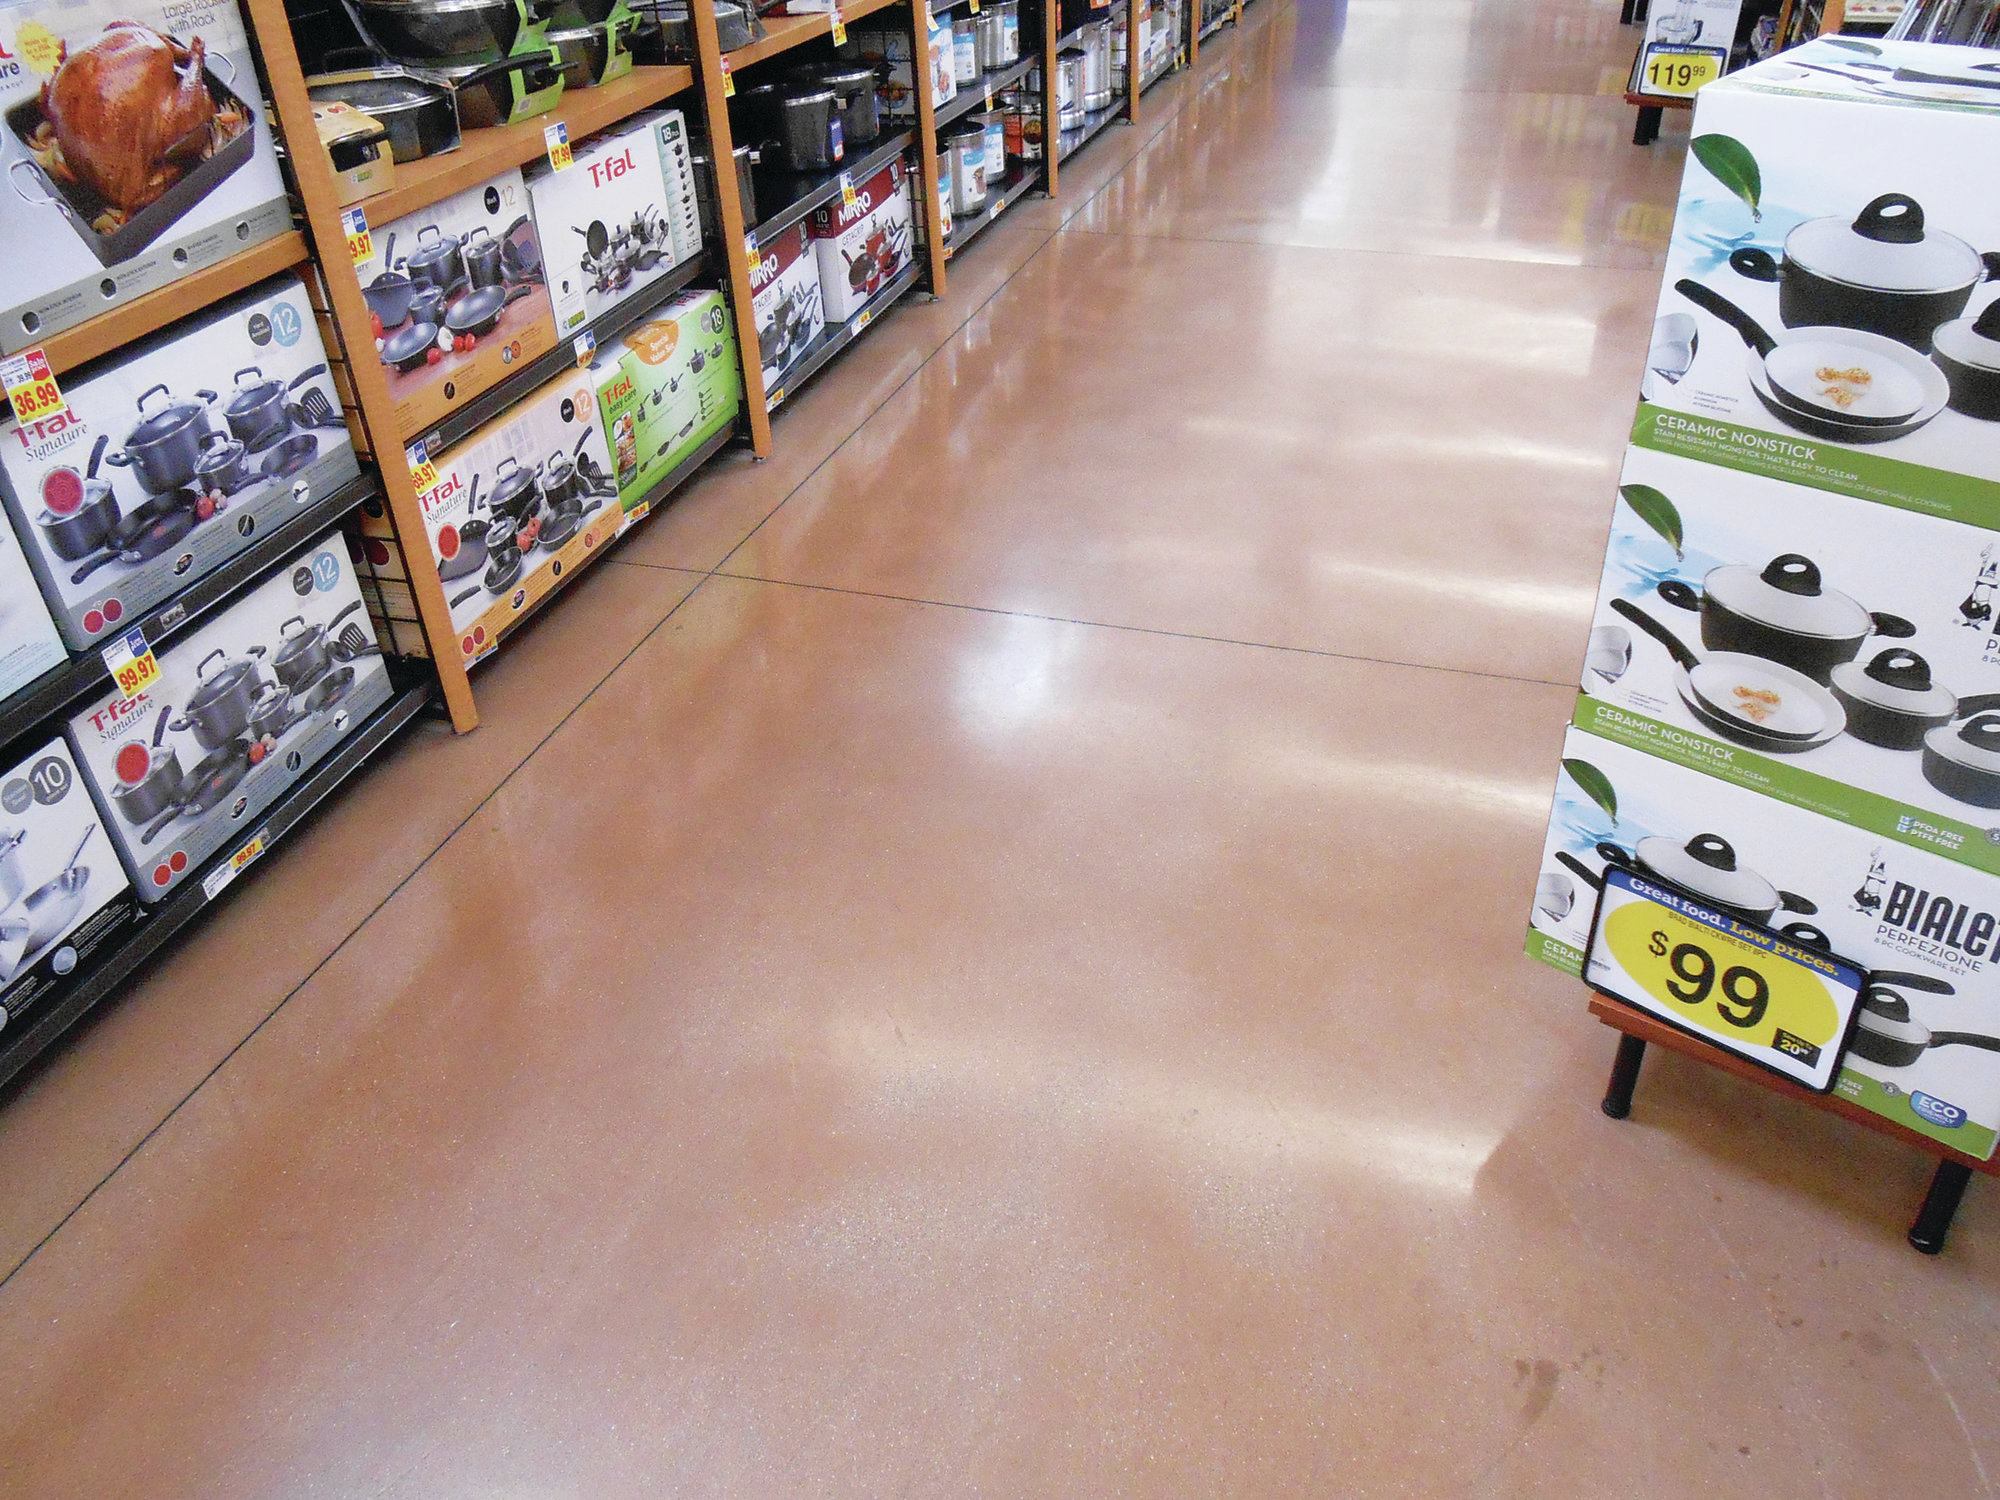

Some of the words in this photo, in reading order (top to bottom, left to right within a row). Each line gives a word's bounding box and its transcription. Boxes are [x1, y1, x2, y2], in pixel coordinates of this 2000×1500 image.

[162, 3, 193, 20] Large
[167, 19, 191, 35] with
[587, 148, 637, 189] T-fal
[815, 210, 828, 223] 10
[838, 191, 871, 227] MIRRO
[274, 307, 298, 336] 12
[711, 308, 722, 328] 18
[14, 382, 59, 416] 36.99
[25, 424, 87, 462] Signature
[1654, 428, 1676, 439] STAIN
[1718, 442, 1761, 459] NONSTICK
[1814, 465, 1827, 473] TO
[1828, 467, 1858, 481] CLEAN
[1655, 413, 1728, 441] CERAMIC
[1731, 431, 1817, 461] NONSTICK
[315, 556, 336, 583] 12
[119, 654, 155, 692] 99.97
[100, 699, 154, 743] Signature
[1596, 706, 1658, 735] CERAMIC
[1661, 728, 1735, 762] NONSTICK
[34, 762, 65, 794] 10
[1629, 877, 1680, 908] Great
[1681, 899, 1727, 928] food.
[1729, 919, 1771, 946] Low
[1772, 940, 1840, 976] prices.
[1877, 924, 1983, 973] PERFEZIONE
[1895, 944, 1948, 970] COOKWARE
[1949, 966, 1967, 977] SET
[1919, 1095, 1959, 1119] ECO
